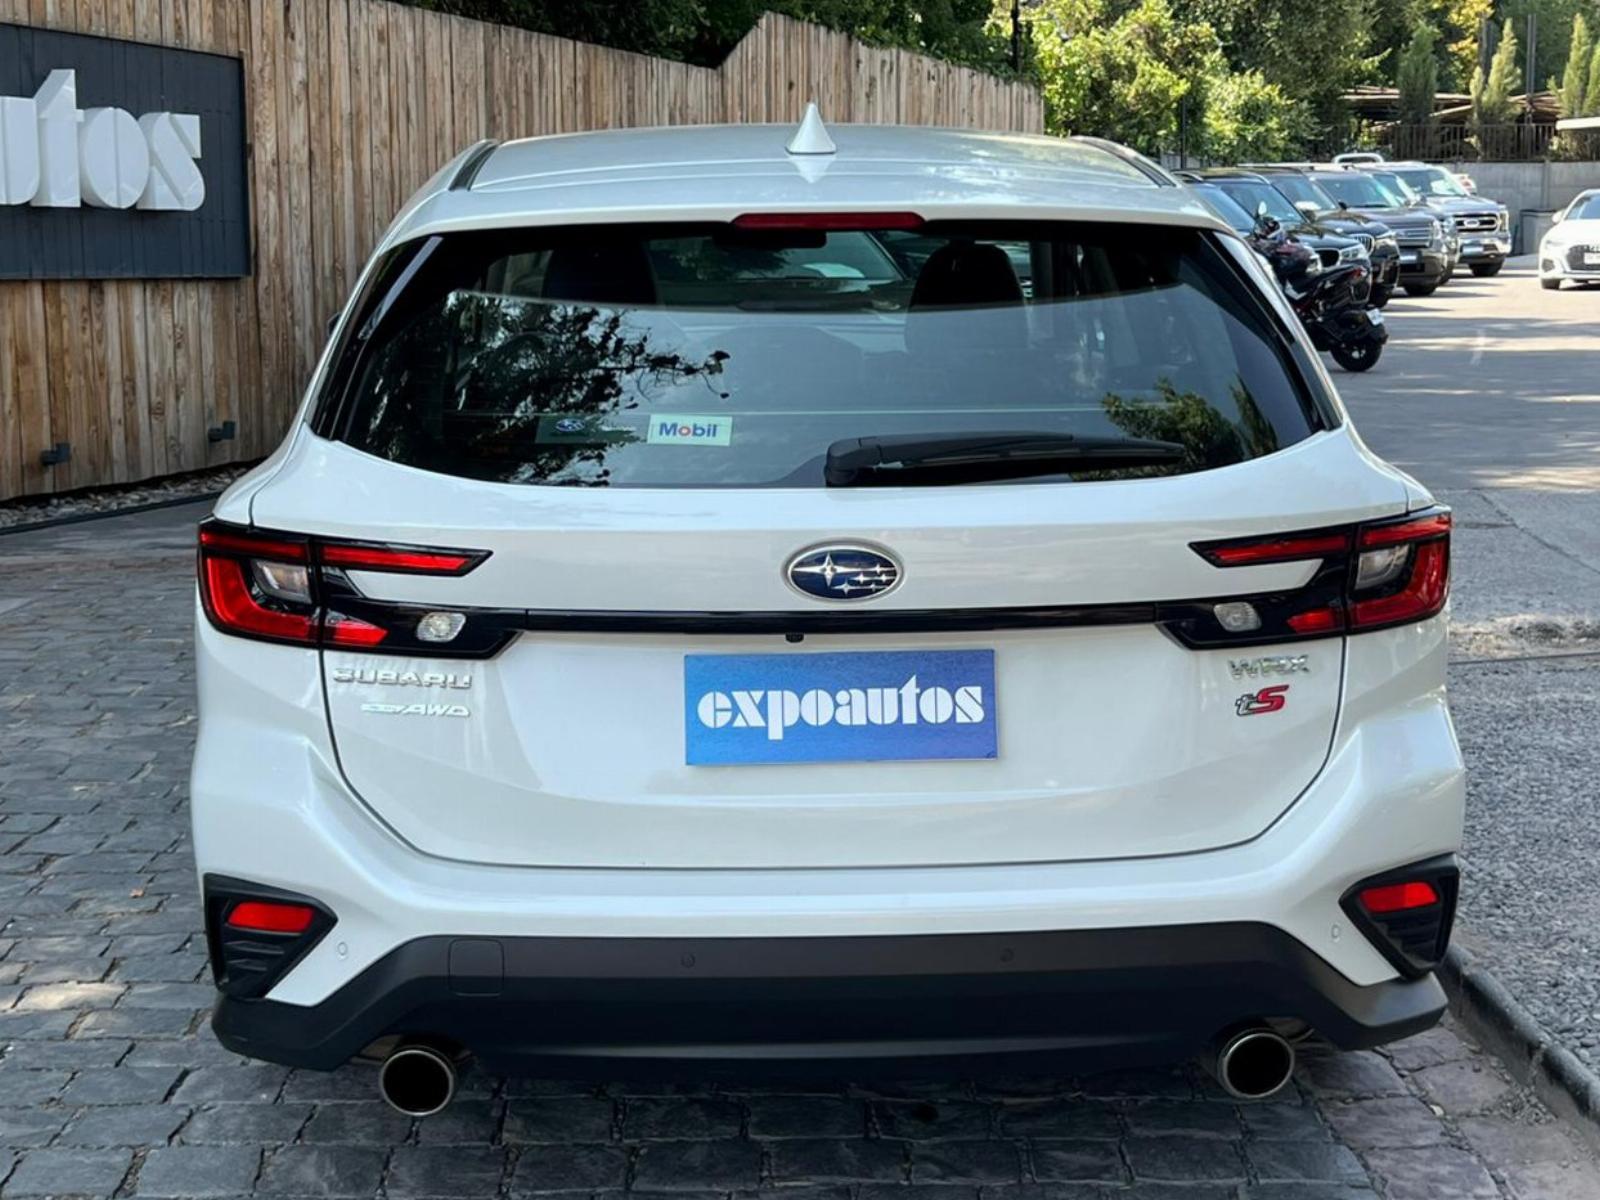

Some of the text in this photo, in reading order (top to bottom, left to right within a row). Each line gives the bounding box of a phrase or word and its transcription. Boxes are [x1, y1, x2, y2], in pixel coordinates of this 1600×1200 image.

[658, 422, 718, 438] Mobil
[332, 667, 473, 690] SUBARU
[1228, 655, 1310, 680] WRX
[697, 674, 986, 740] expoautos
